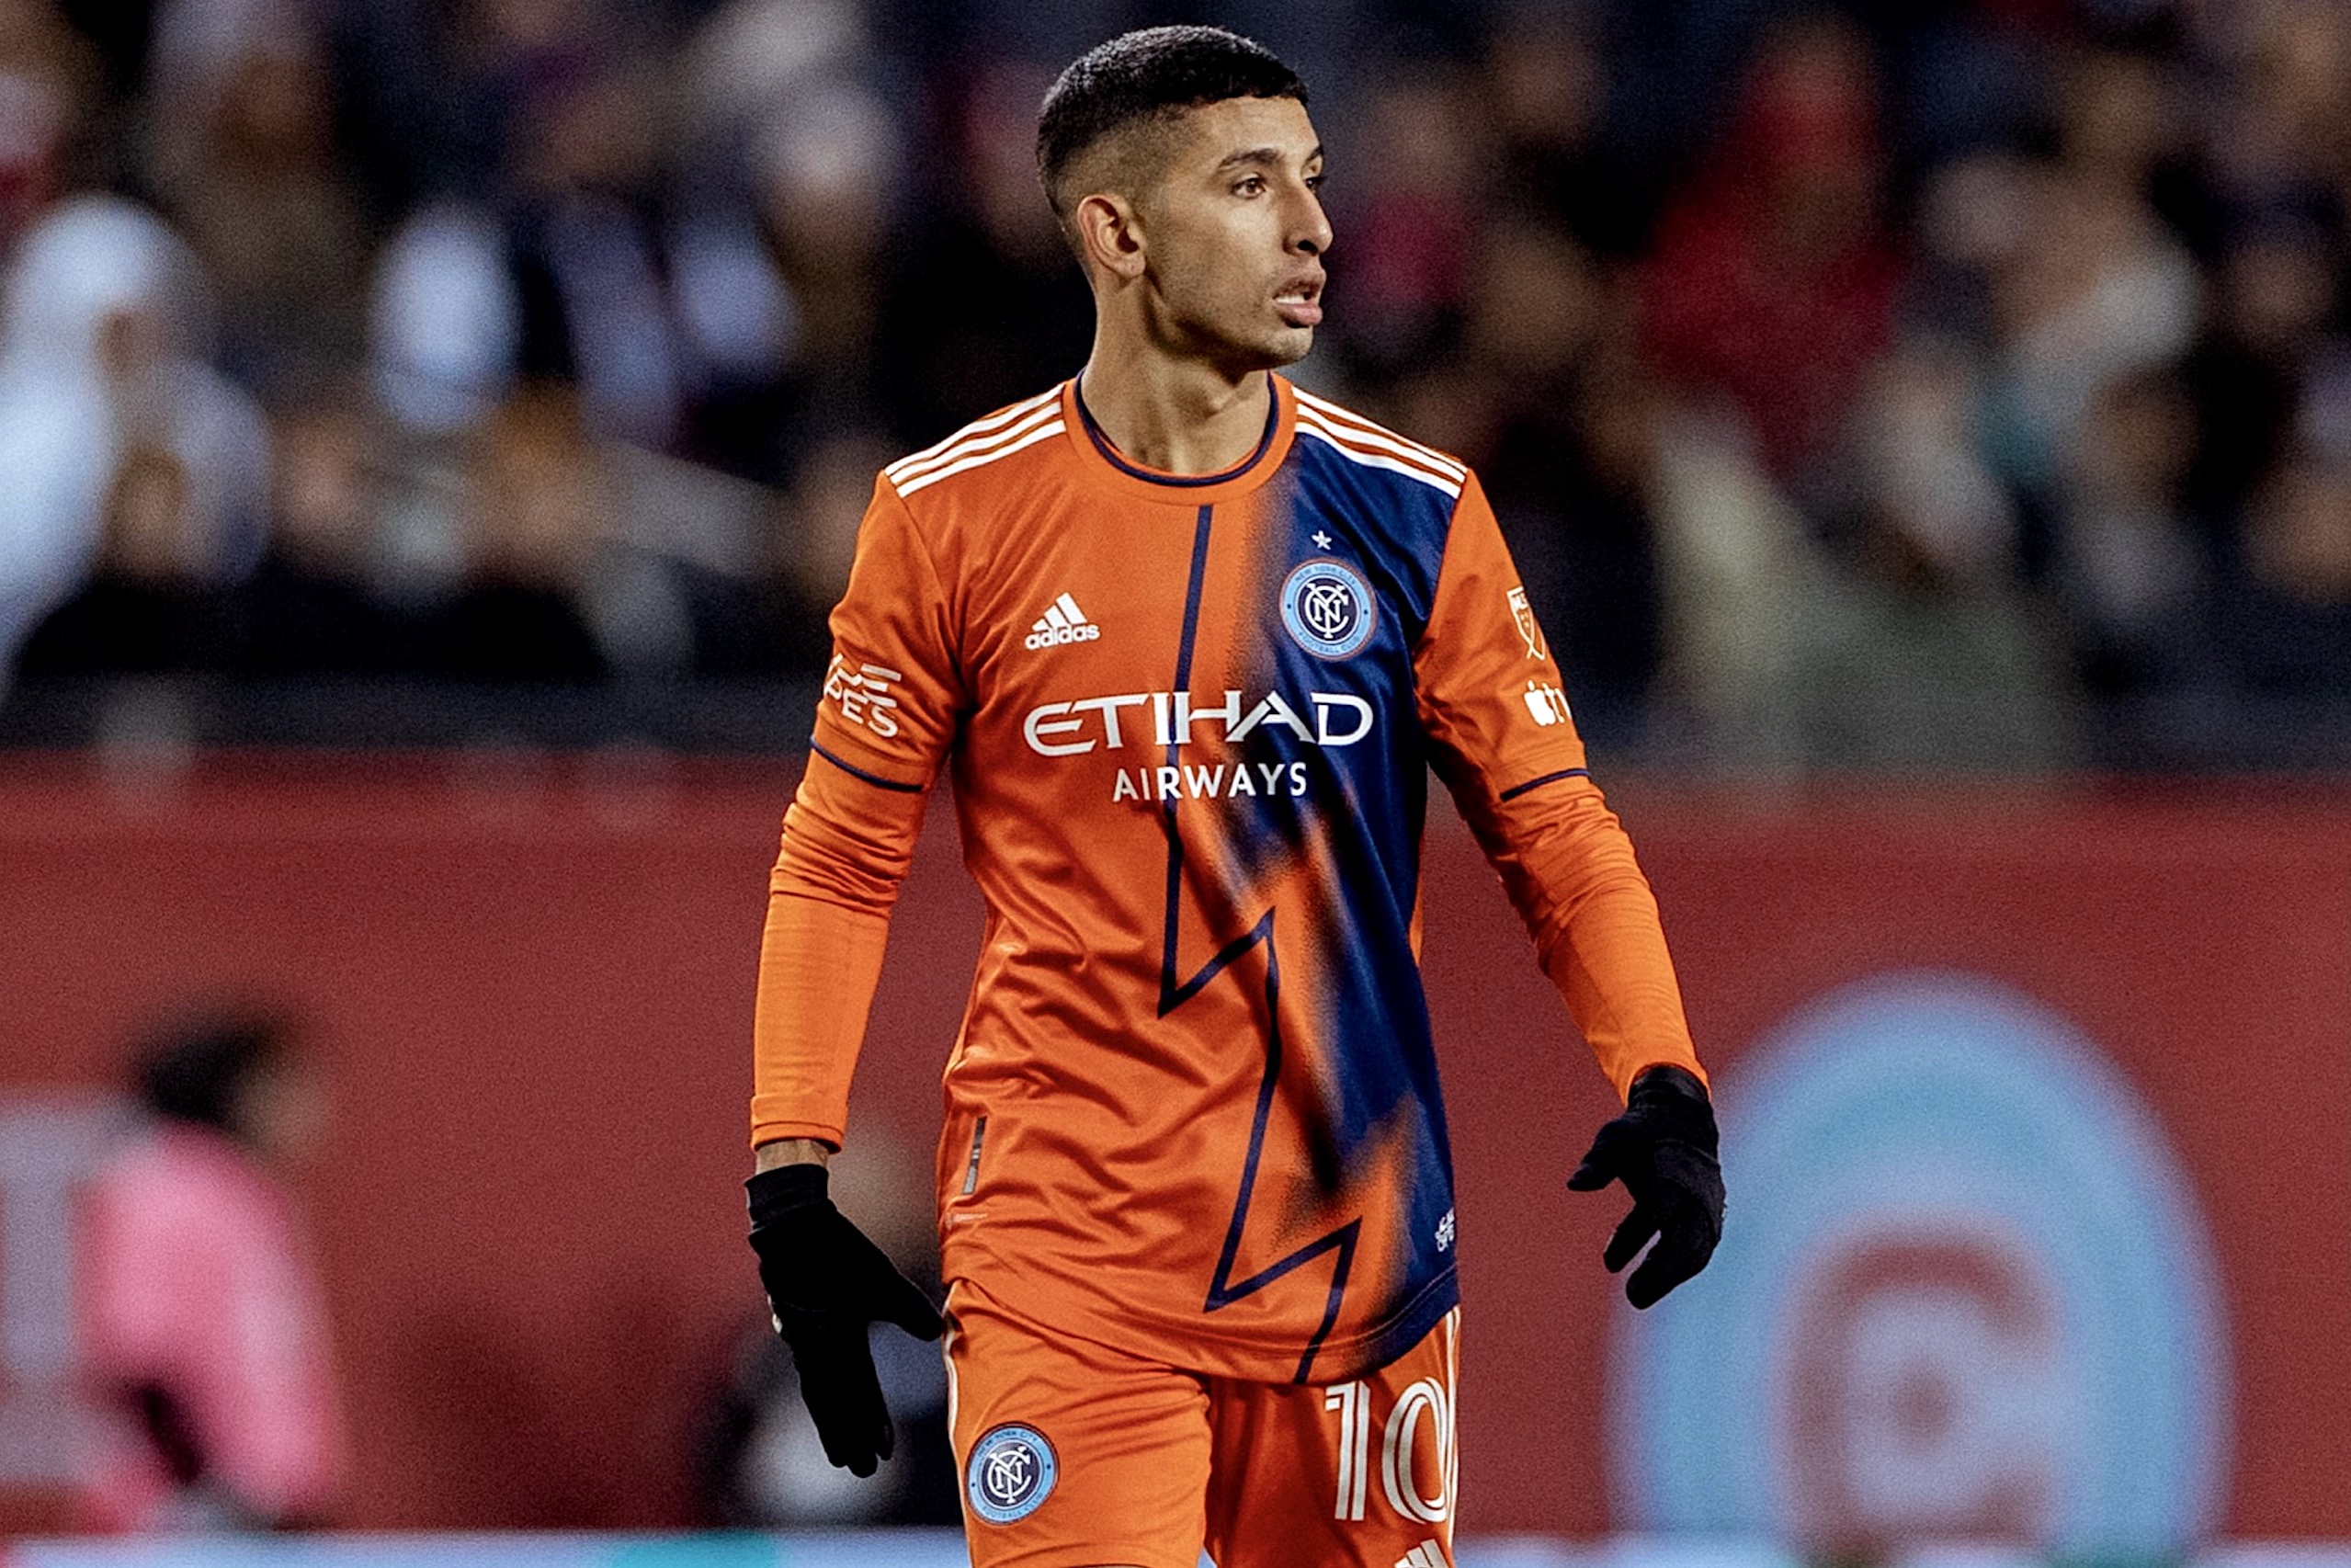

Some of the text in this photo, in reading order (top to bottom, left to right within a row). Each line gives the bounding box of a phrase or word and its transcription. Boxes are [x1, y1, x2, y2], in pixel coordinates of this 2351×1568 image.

[1024, 622, 1100, 651] adidas
[823, 673, 898, 737] PES
[1023, 690, 1373, 756] ETIHAD
[1112, 762, 1308, 802] AIRWAYS
[1324, 1376, 1447, 1525] 10
